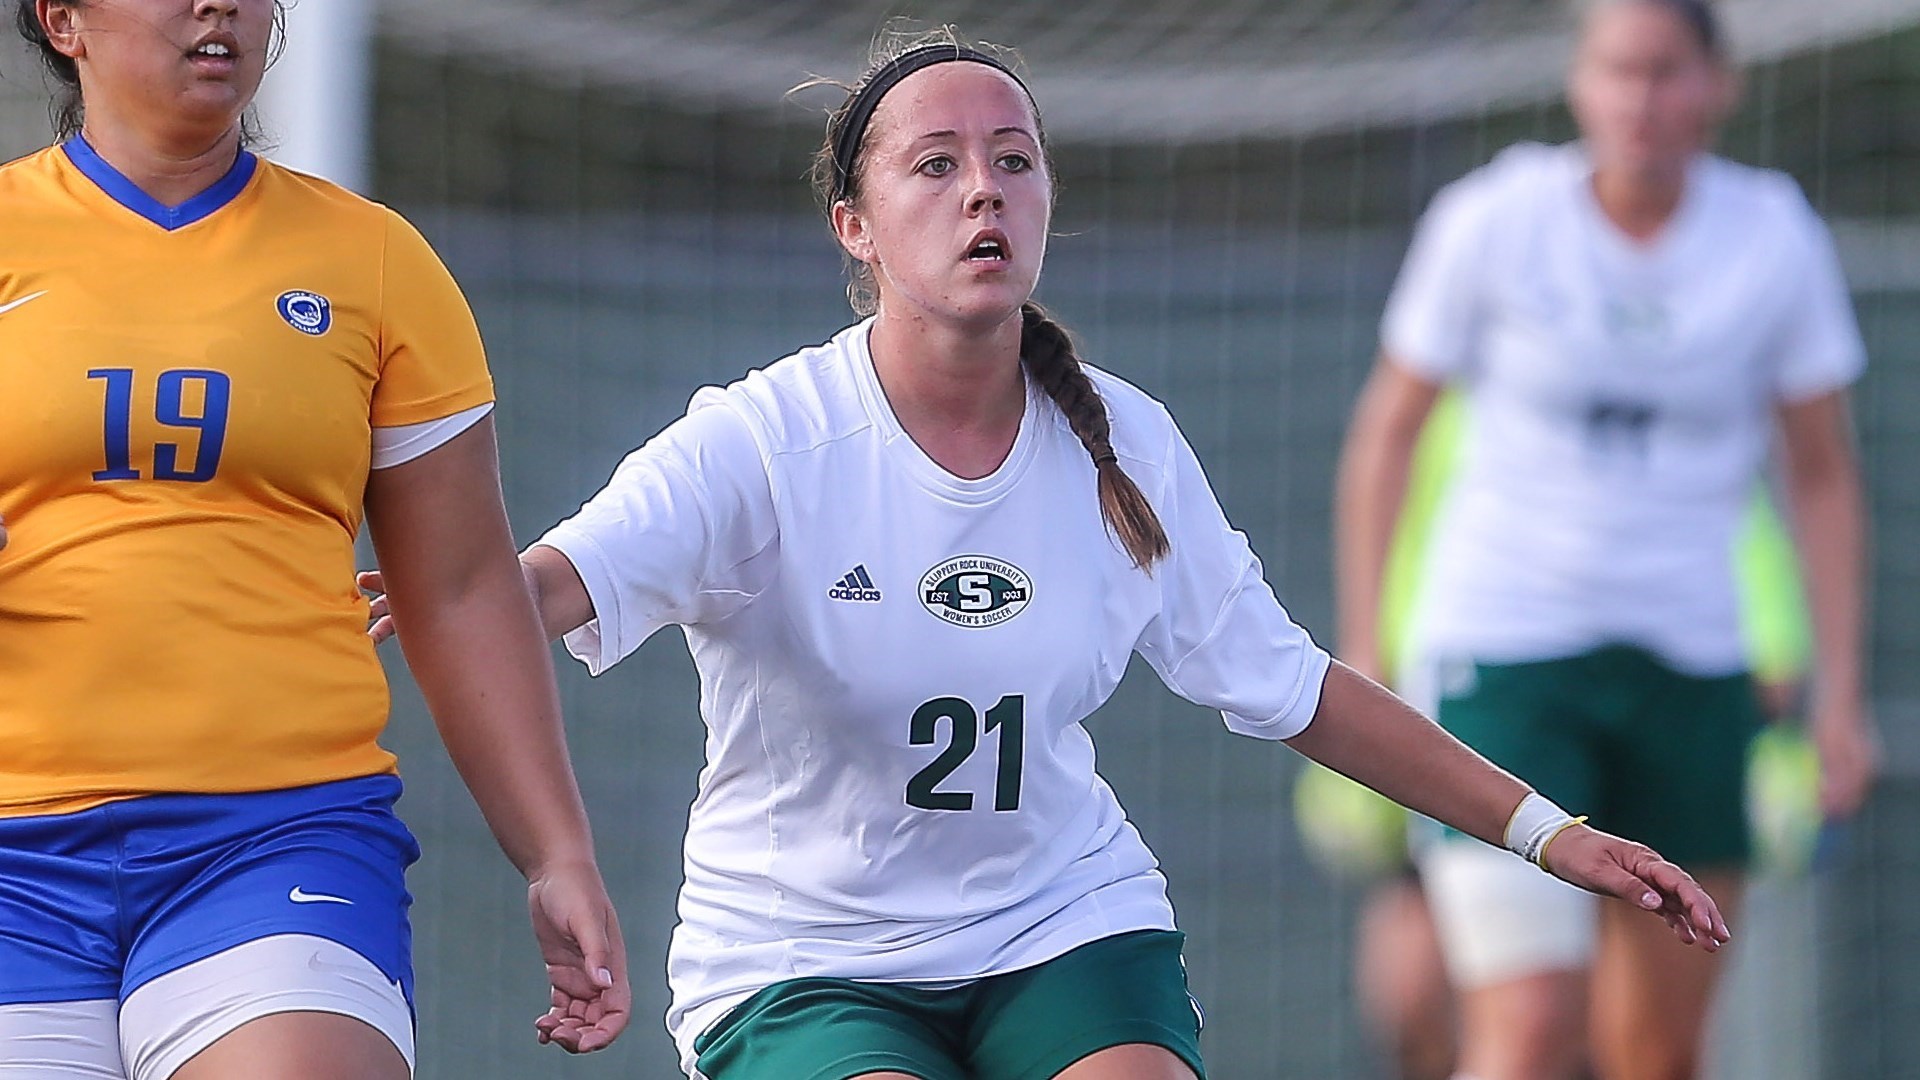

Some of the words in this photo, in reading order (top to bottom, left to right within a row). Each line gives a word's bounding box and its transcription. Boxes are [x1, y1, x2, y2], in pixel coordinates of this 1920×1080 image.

[87, 368, 231, 483] 19
[925, 560, 959, 587] SLIPPERY
[960, 560, 978, 569] ROCK
[979, 560, 1025, 585] UNIVERSITY
[829, 588, 881, 602] adidas
[958, 574, 992, 610] S
[943, 608, 979, 625] WOMEN'S
[981, 607, 1013, 624] SOCCER
[905, 694, 1025, 812] 21
